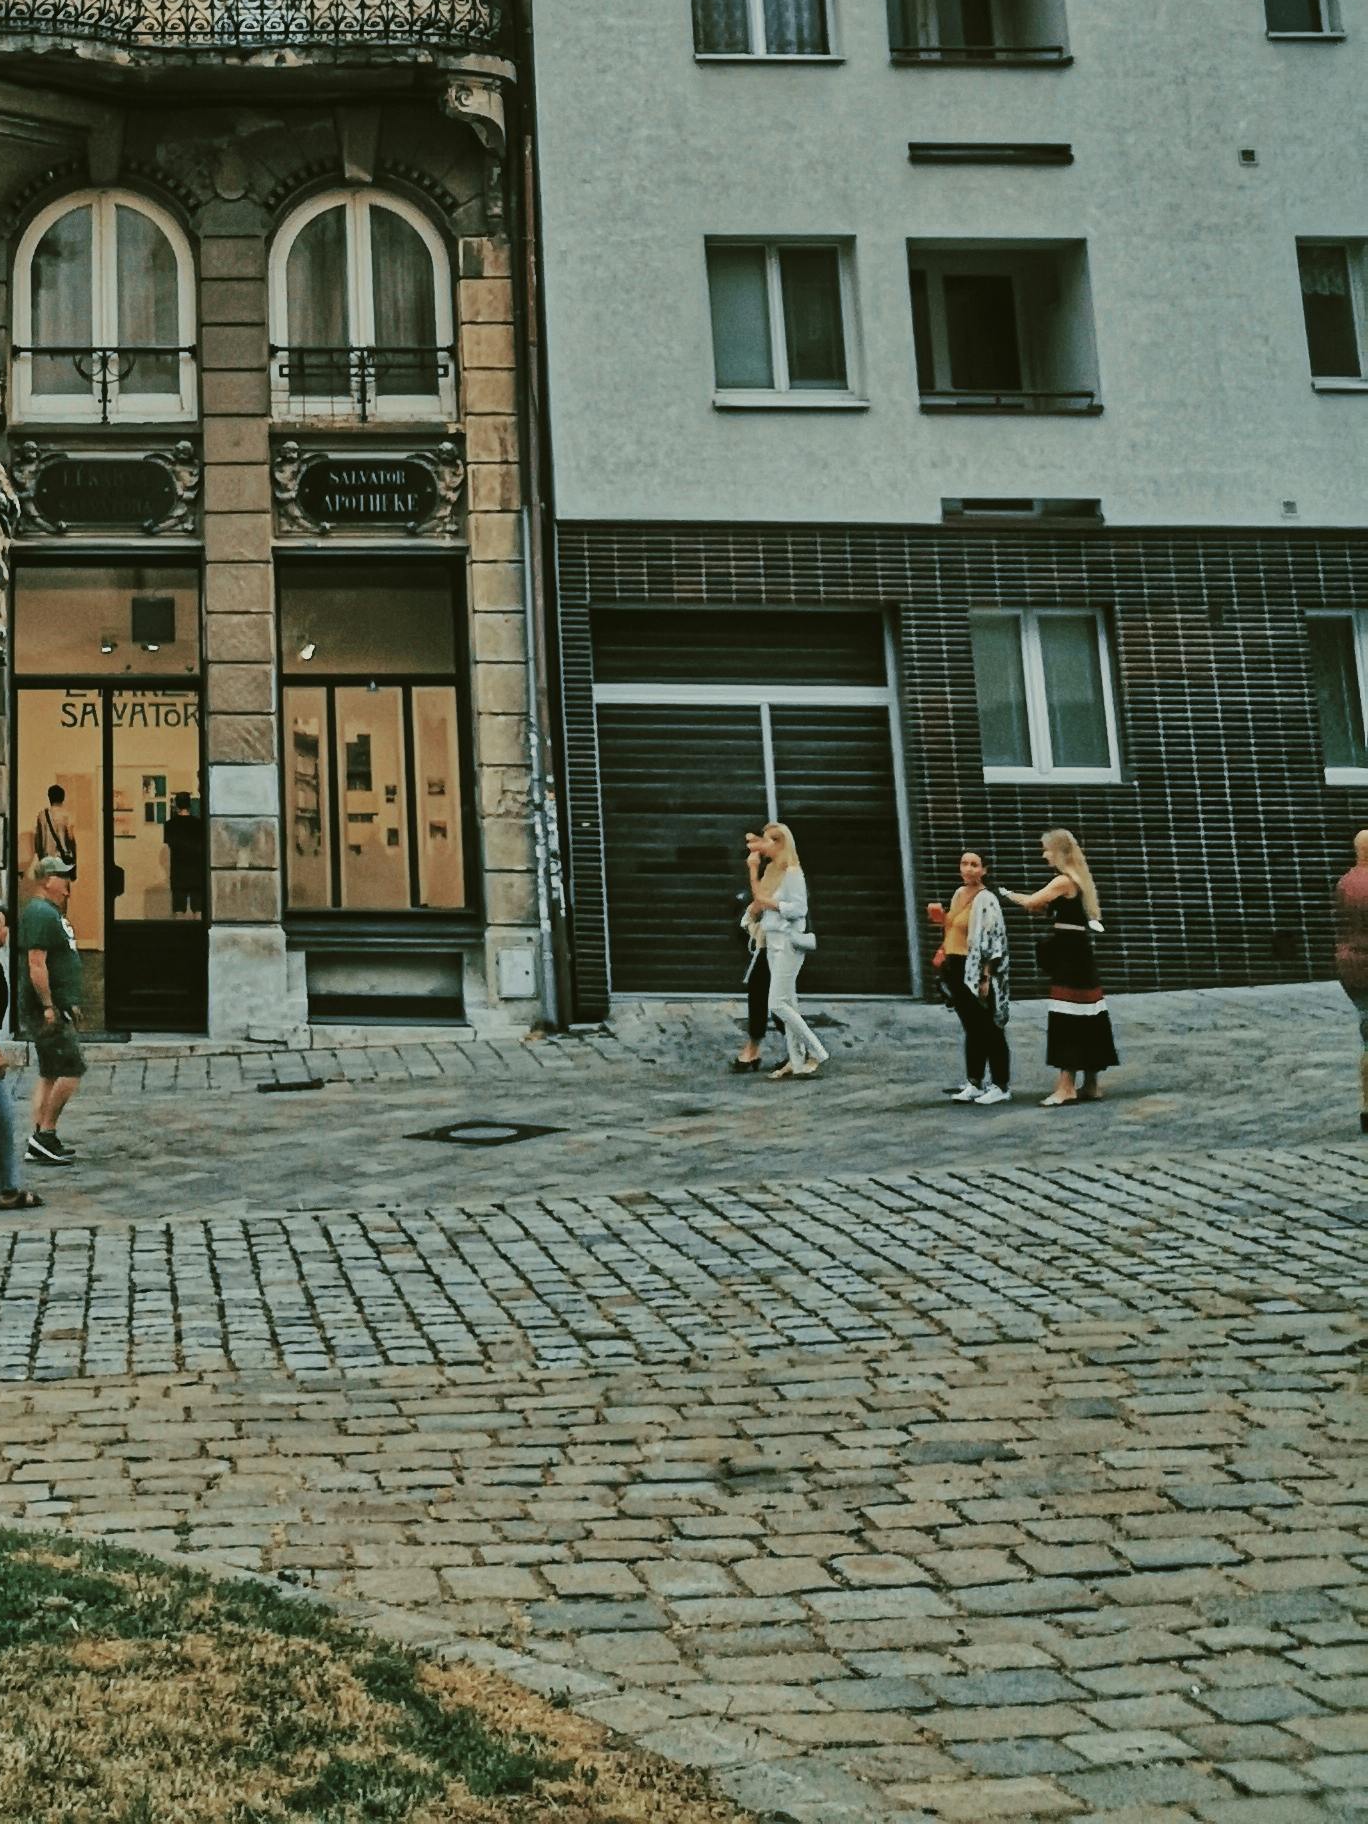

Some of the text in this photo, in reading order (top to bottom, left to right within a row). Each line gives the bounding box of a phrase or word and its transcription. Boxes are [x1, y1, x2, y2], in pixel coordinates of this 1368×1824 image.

[329, 470, 406, 485] SALVATOR
[324, 493, 419, 513] APOTHEKE
[60, 702, 199, 728] SAVATOR
